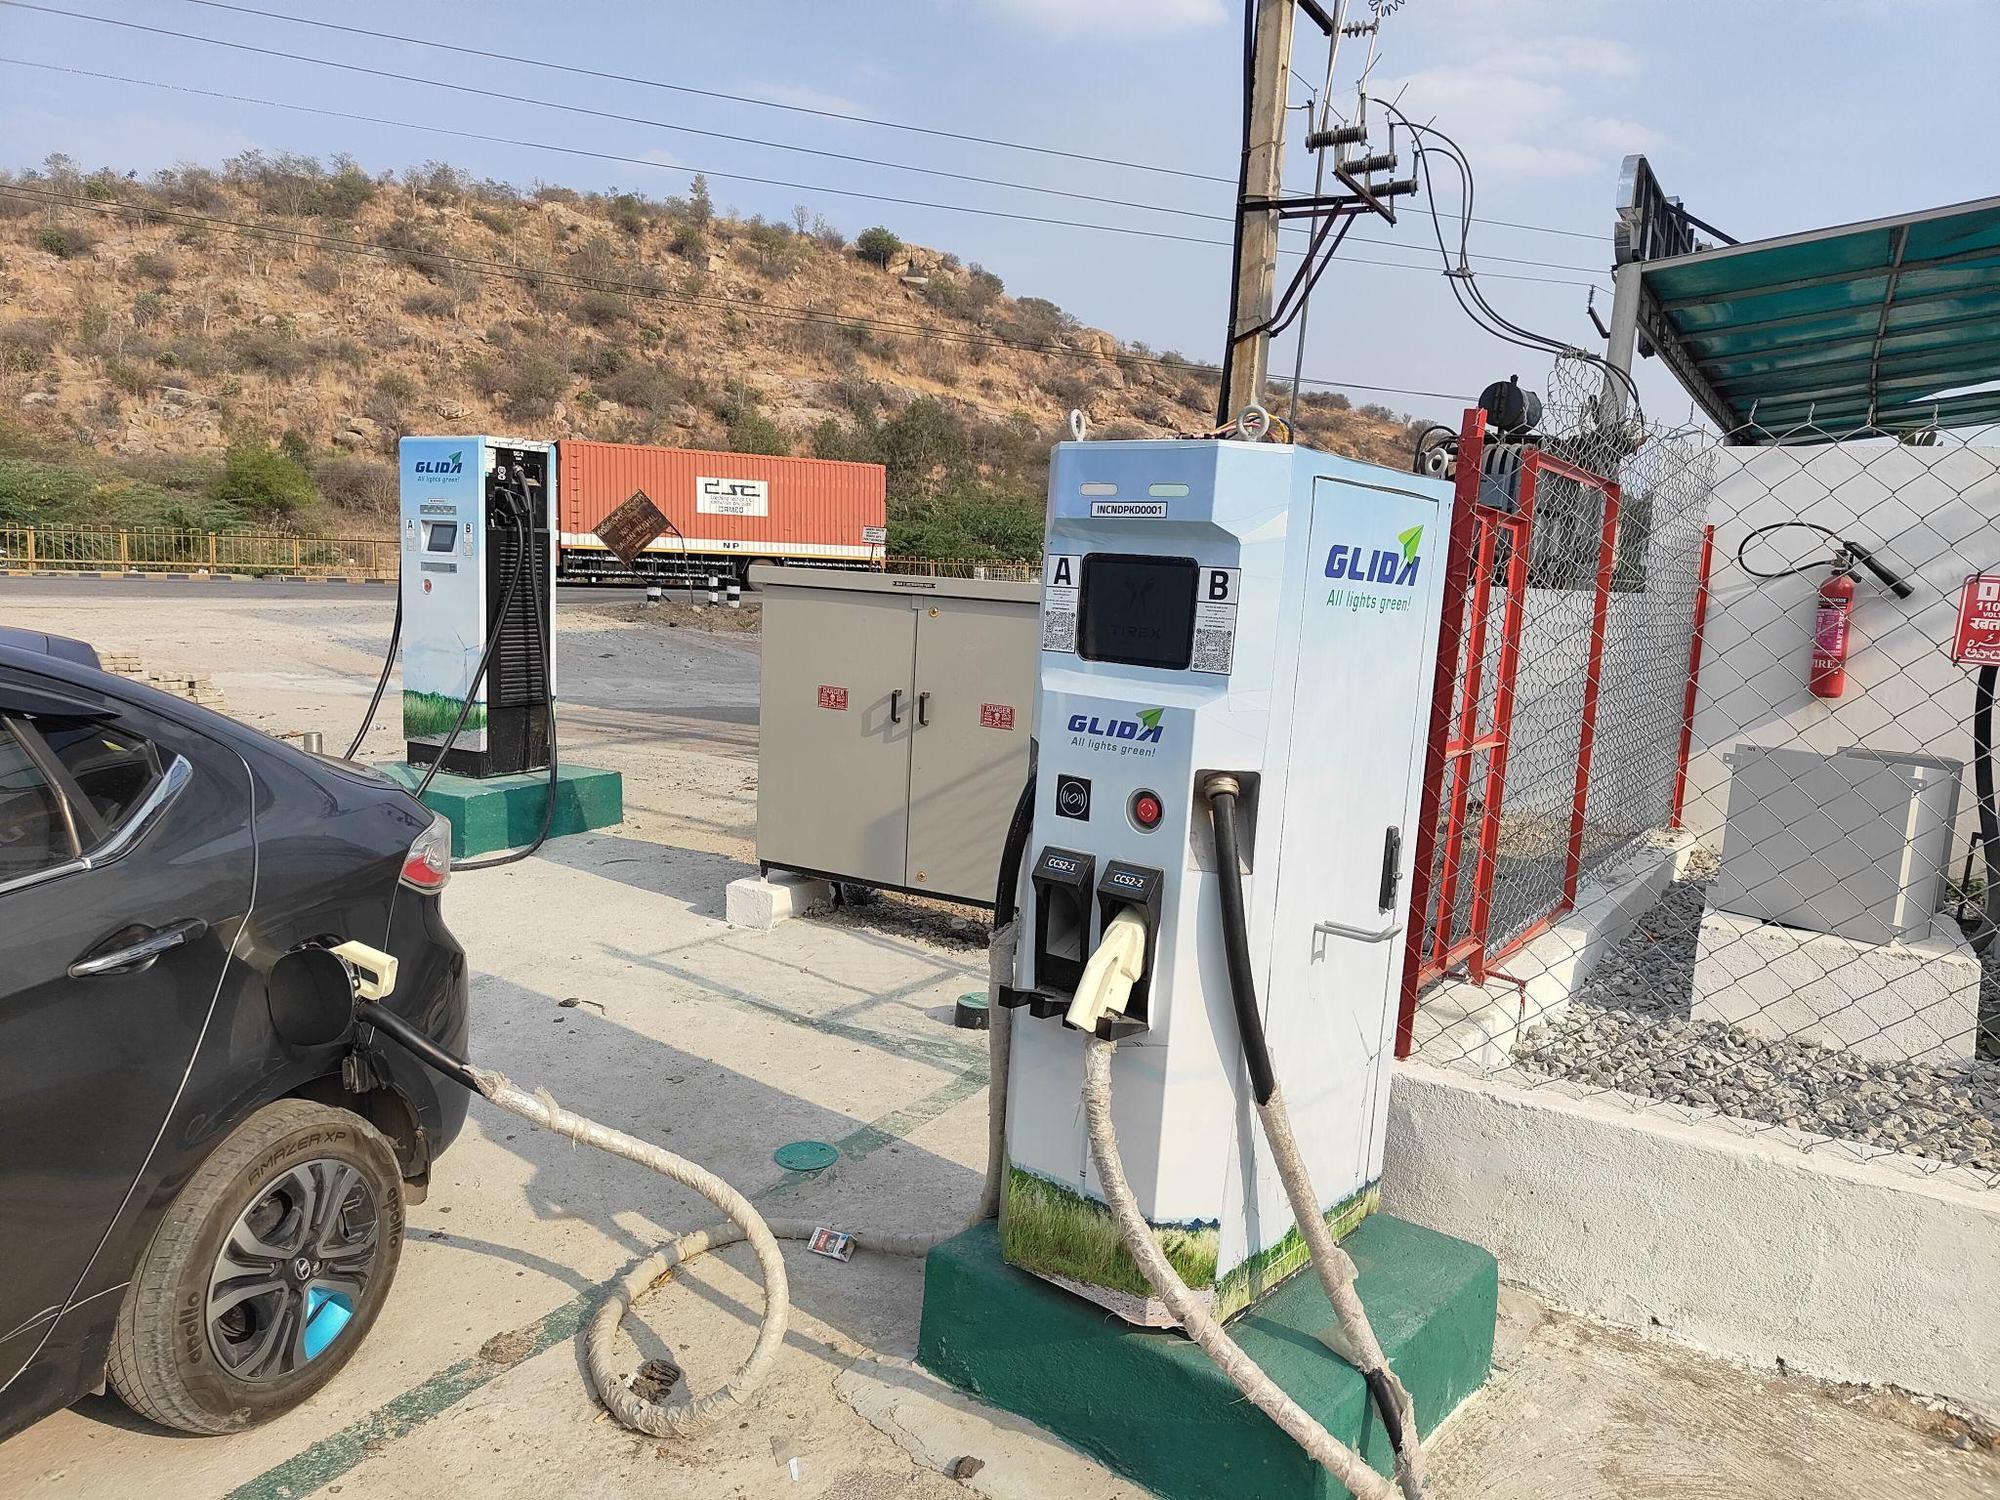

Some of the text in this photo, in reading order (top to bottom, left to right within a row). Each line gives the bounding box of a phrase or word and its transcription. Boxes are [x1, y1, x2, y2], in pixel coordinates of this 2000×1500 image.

[415, 461, 463, 474] GLIDA
[407, 520, 413, 529] A
[465, 523, 471, 533] B
[1053, 557, 1071, 585] A
[1324, 544, 1421, 586] GLIDA
[1208, 570, 1229, 600] B
[1326, 589, 1412, 614] All lights green!
[1067, 714, 1164, 743] GLIDA
[1071, 736, 1156, 758] All lights green!
[1048, 858, 1076, 871] CCS2-1
[1113, 874, 1144, 888] CCS2-2
[247, 1131, 347, 1186] AMAZER XP
[382, 1186, 402, 1249] apollo
[178, 1291, 203, 1364] apollo
